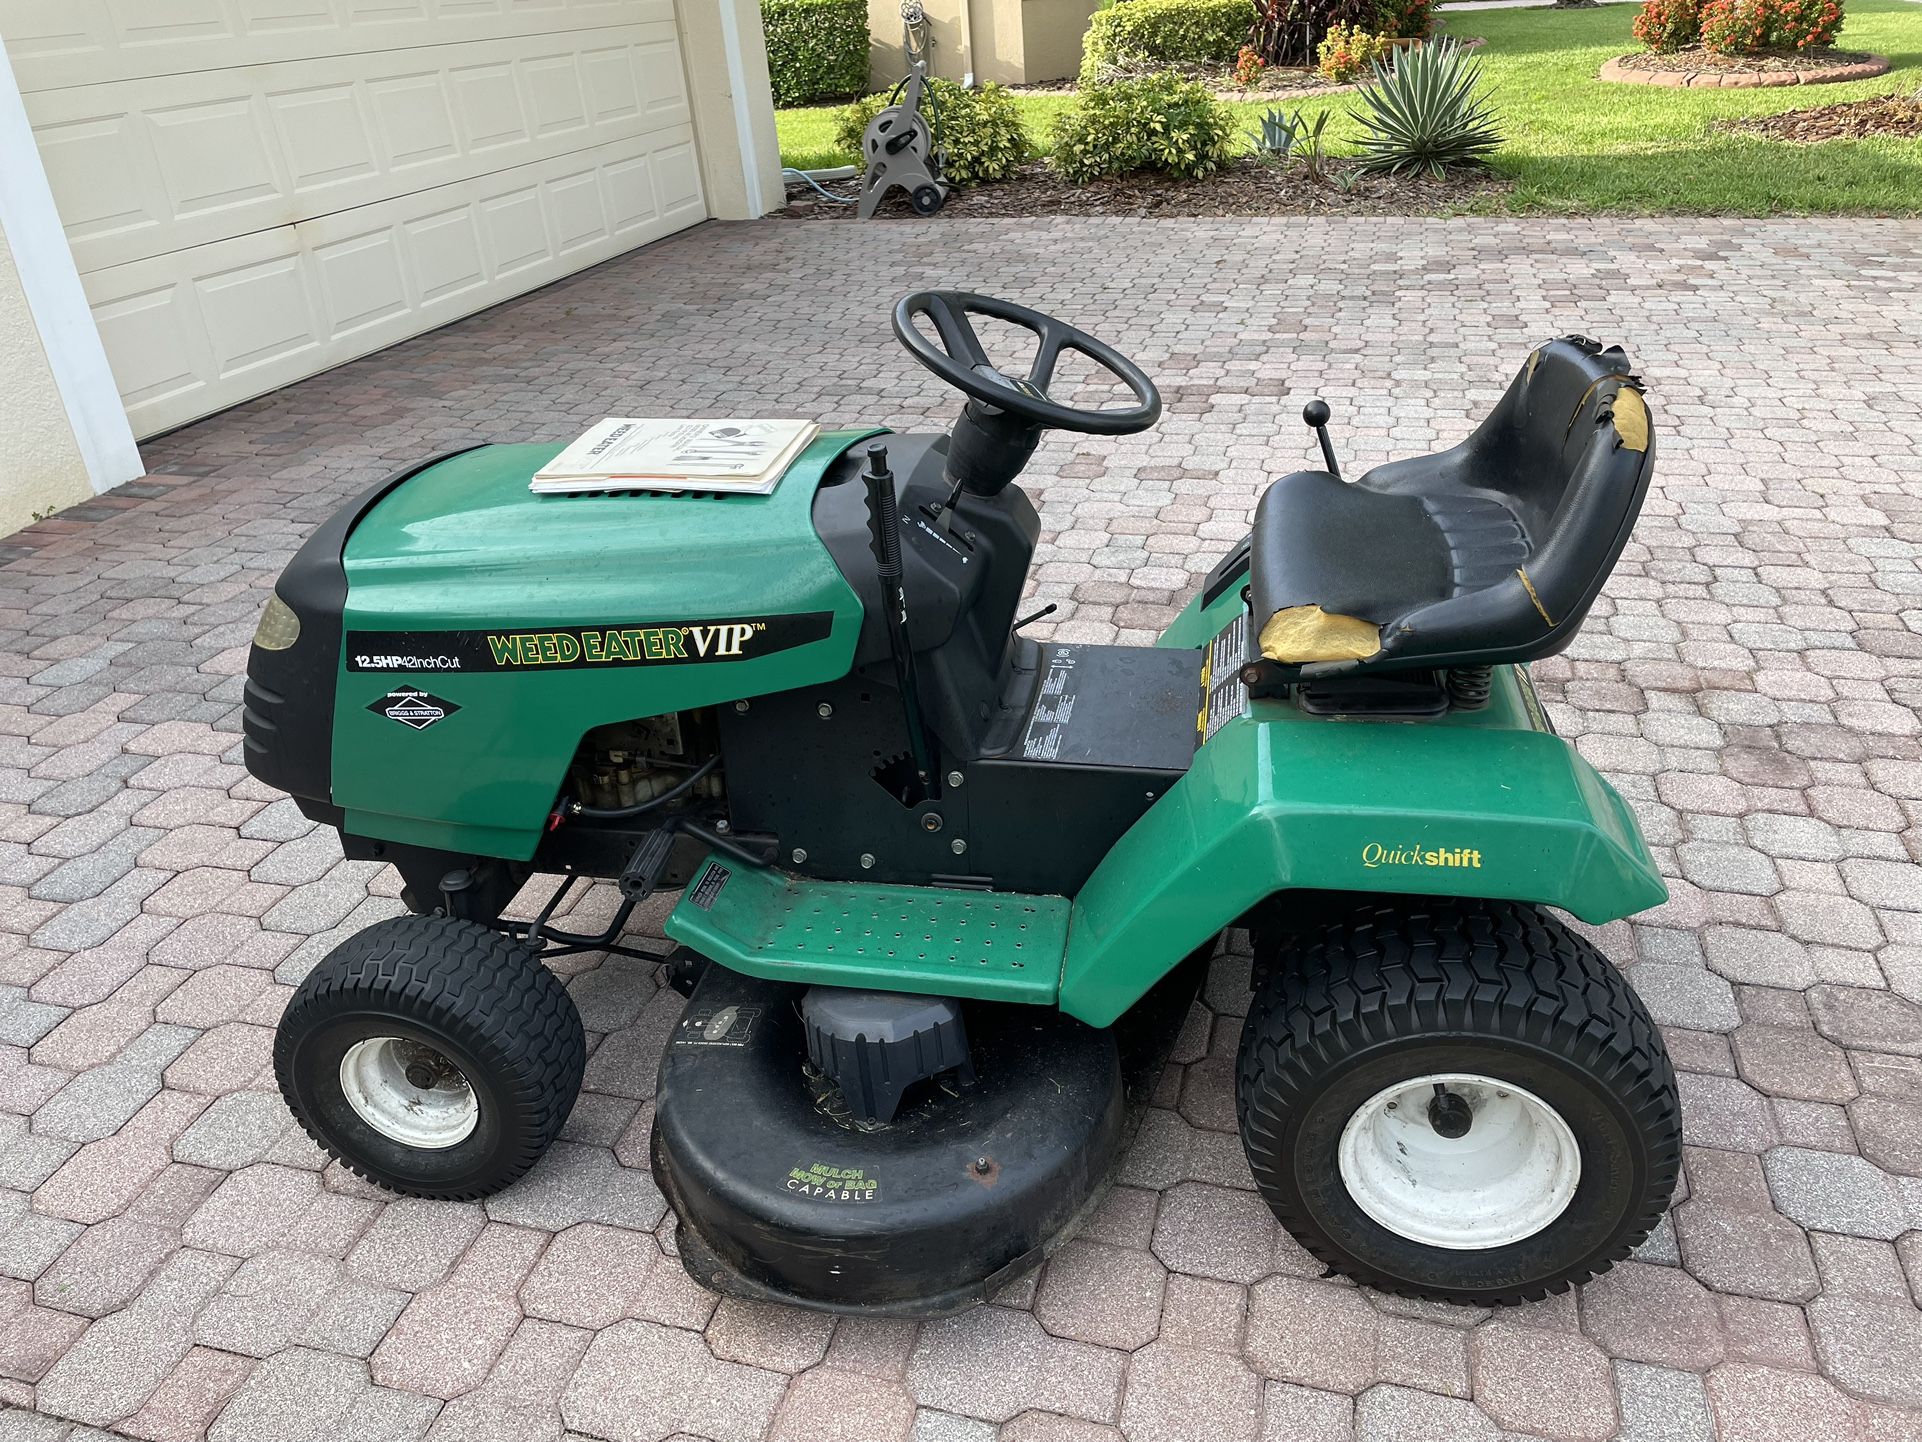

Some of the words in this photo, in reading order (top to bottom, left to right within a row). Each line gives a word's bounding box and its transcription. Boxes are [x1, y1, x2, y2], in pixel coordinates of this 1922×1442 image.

[586, 438, 618, 455] EATER
[487, 633, 580, 666] WEED
[1362, 842, 1481, 868] Quickshift
[789, 1167, 827, 1186] MOW
[826, 1180, 842, 1189] or
[844, 1179, 878, 1190] BAG
[810, 1163, 864, 1179] MULCH
[787, 1179, 874, 1200] CAPABLE
